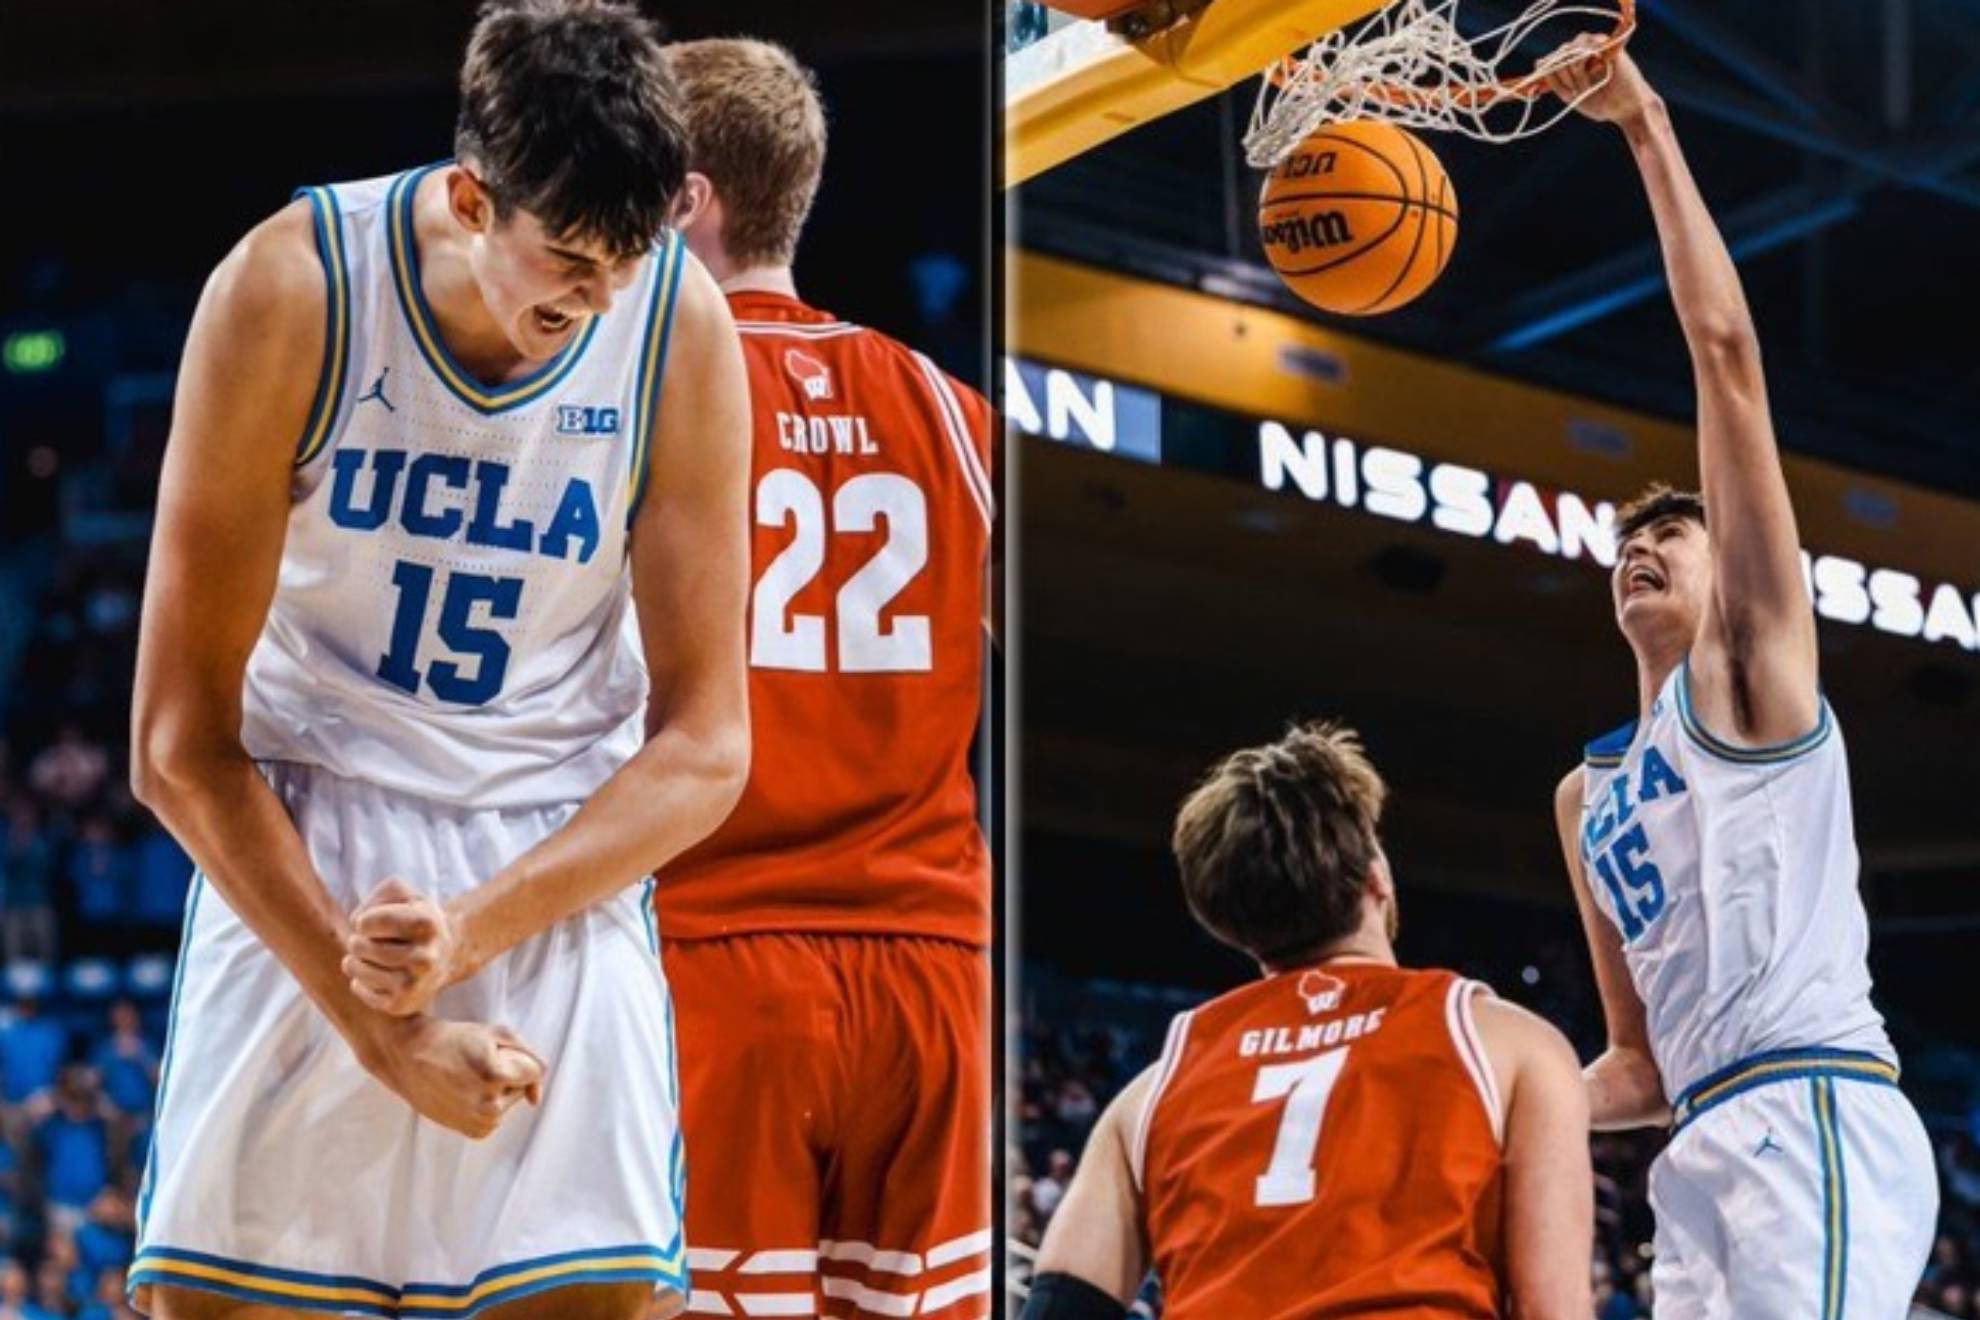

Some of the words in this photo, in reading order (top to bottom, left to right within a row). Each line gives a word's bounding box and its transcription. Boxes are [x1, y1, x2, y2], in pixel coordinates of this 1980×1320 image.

[776, 411, 879, 454] CROWL
[1259, 420, 1618, 568] NISSAN
[328, 448, 601, 564] UCLA
[749, 468, 932, 673] 22
[376, 559, 525, 706] 15
[1595, 822, 1664, 942] 15
[1239, 1007, 1387, 1057] GILMORE
[1251, 1045, 1350, 1206] 7
